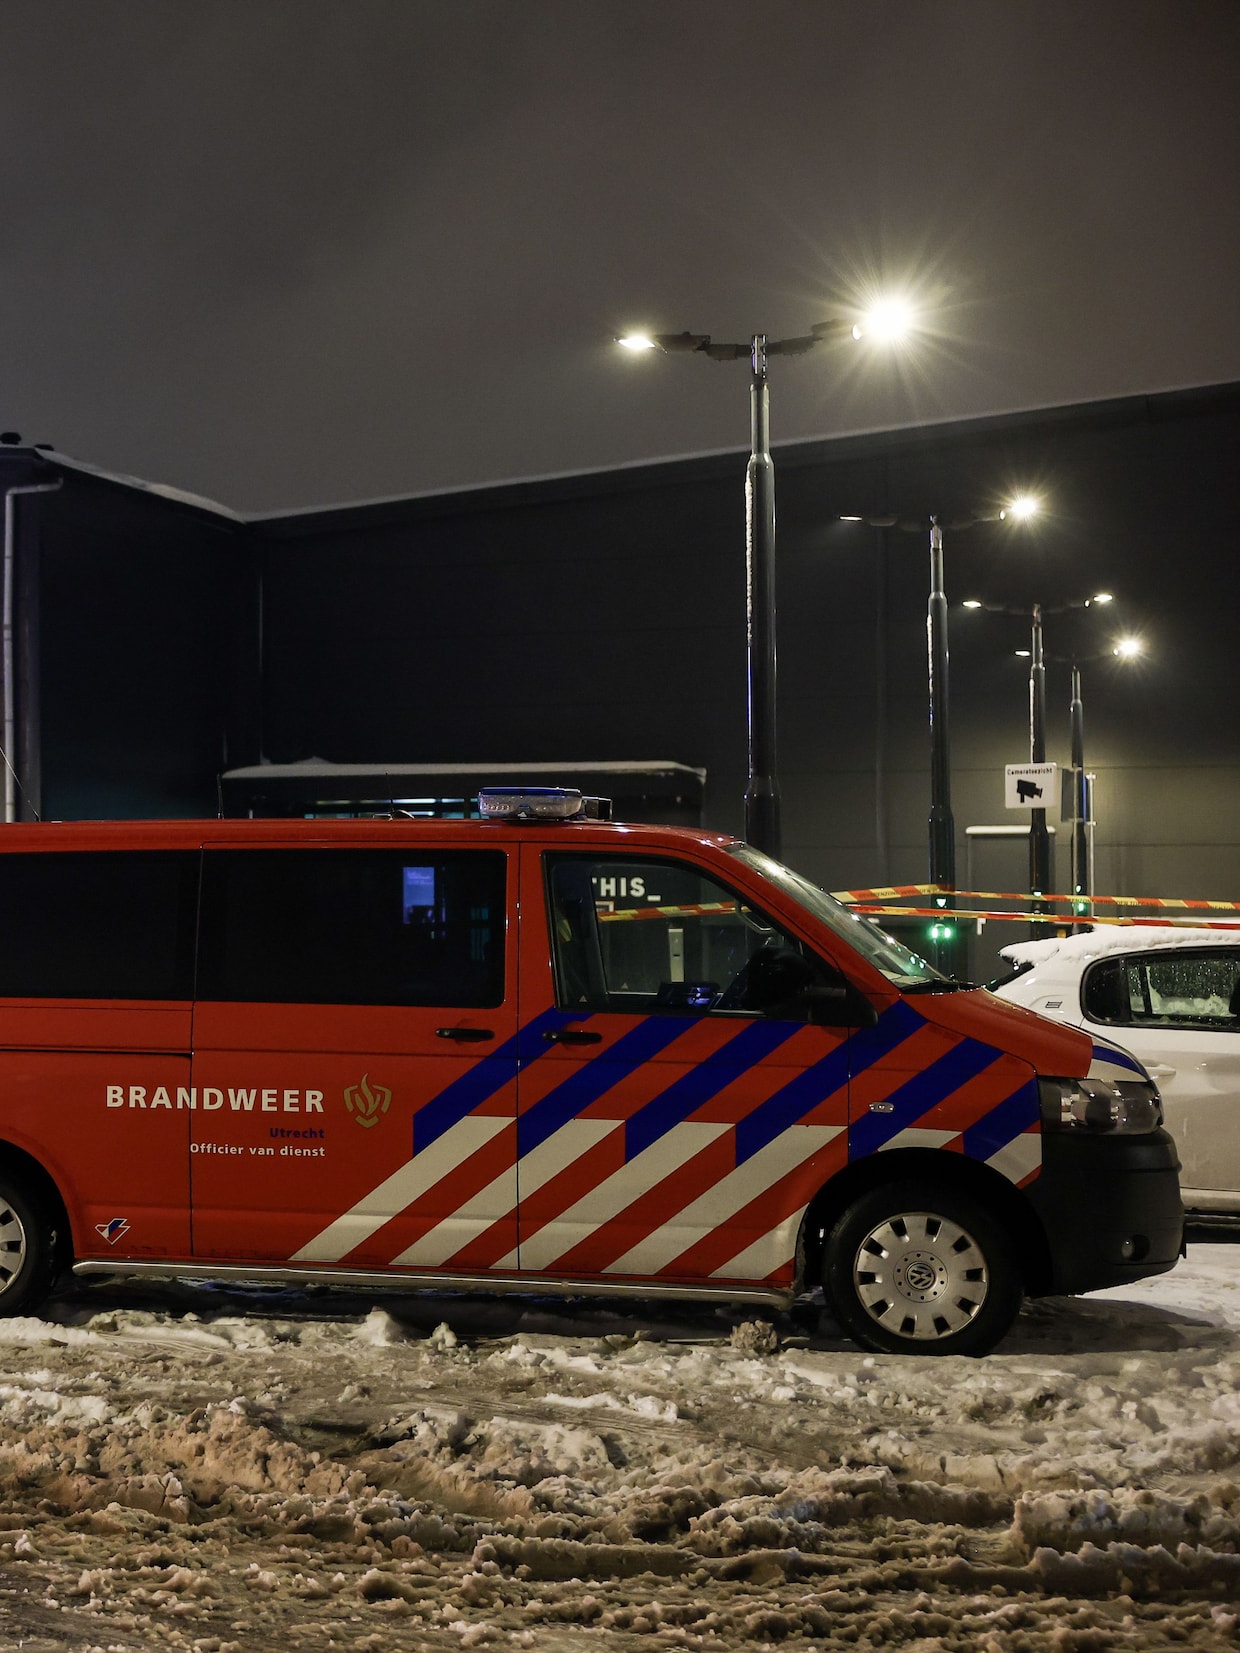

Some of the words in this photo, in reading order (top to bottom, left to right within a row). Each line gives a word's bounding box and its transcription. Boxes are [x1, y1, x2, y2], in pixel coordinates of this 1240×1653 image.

[106, 1085, 325, 1113] BRANDWEER
[269, 1127, 325, 1139] Utrecht
[189, 1143, 244, 1155] Officier
[249, 1147, 275, 1156] van
[279, 1146, 326, 1157] dienst
